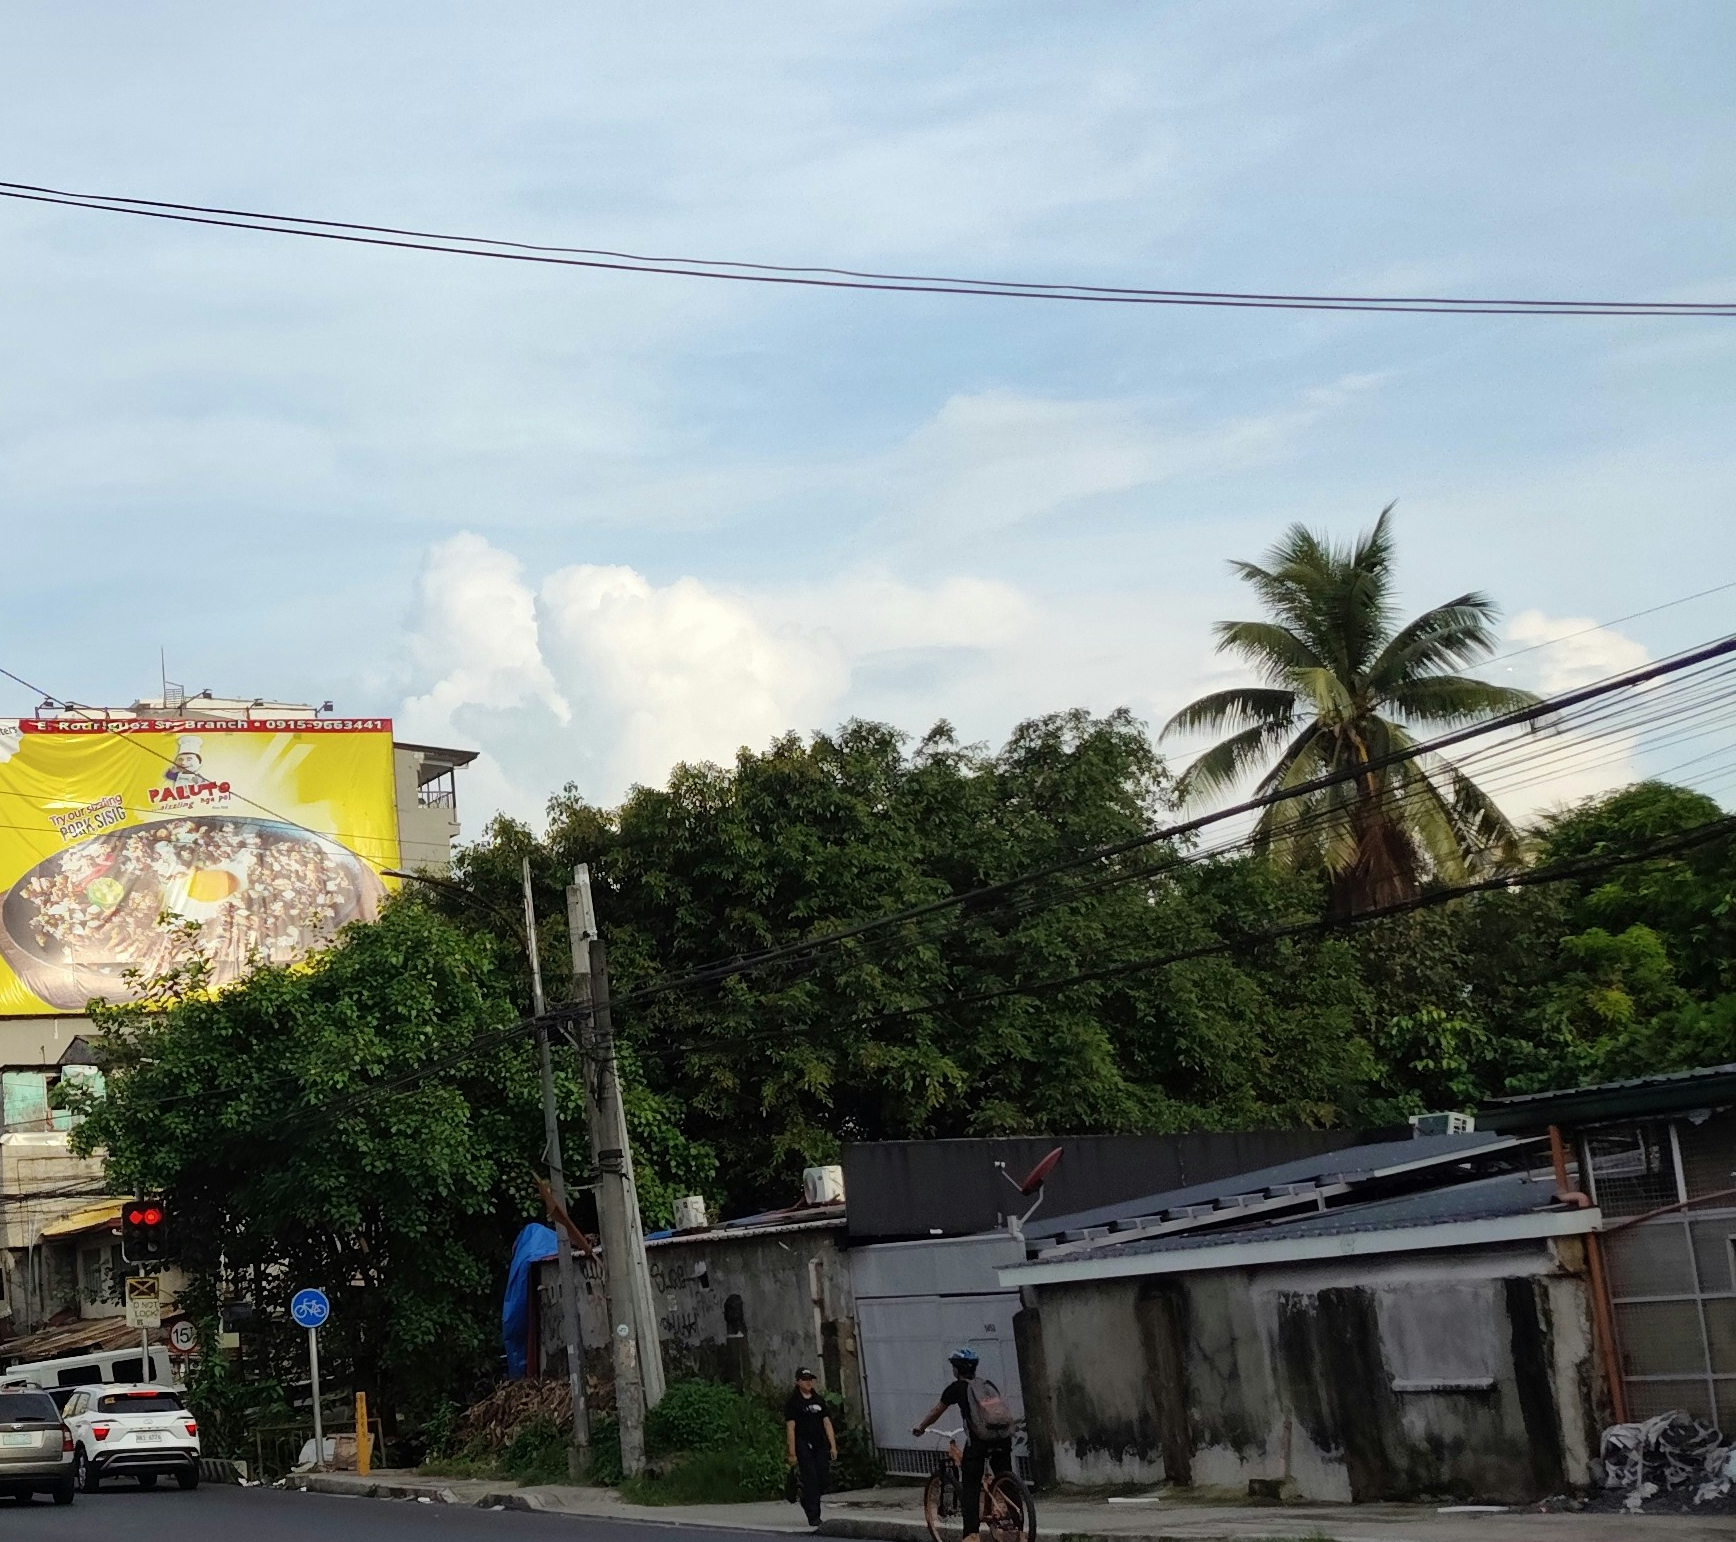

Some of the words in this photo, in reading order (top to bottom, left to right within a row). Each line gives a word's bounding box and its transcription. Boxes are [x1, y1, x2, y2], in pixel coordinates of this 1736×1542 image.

[58, 720, 149, 733] Rodriguez
[185, 720, 248, 730] Branch
[265, 719, 383, 730] 0915-9663441
[148, 781, 231, 804] PALUTO
[49, 815, 67, 827] Try
[68, 807, 85, 821] our
[60, 817, 96, 841] PORK
[94, 805, 126, 829] SISIG
